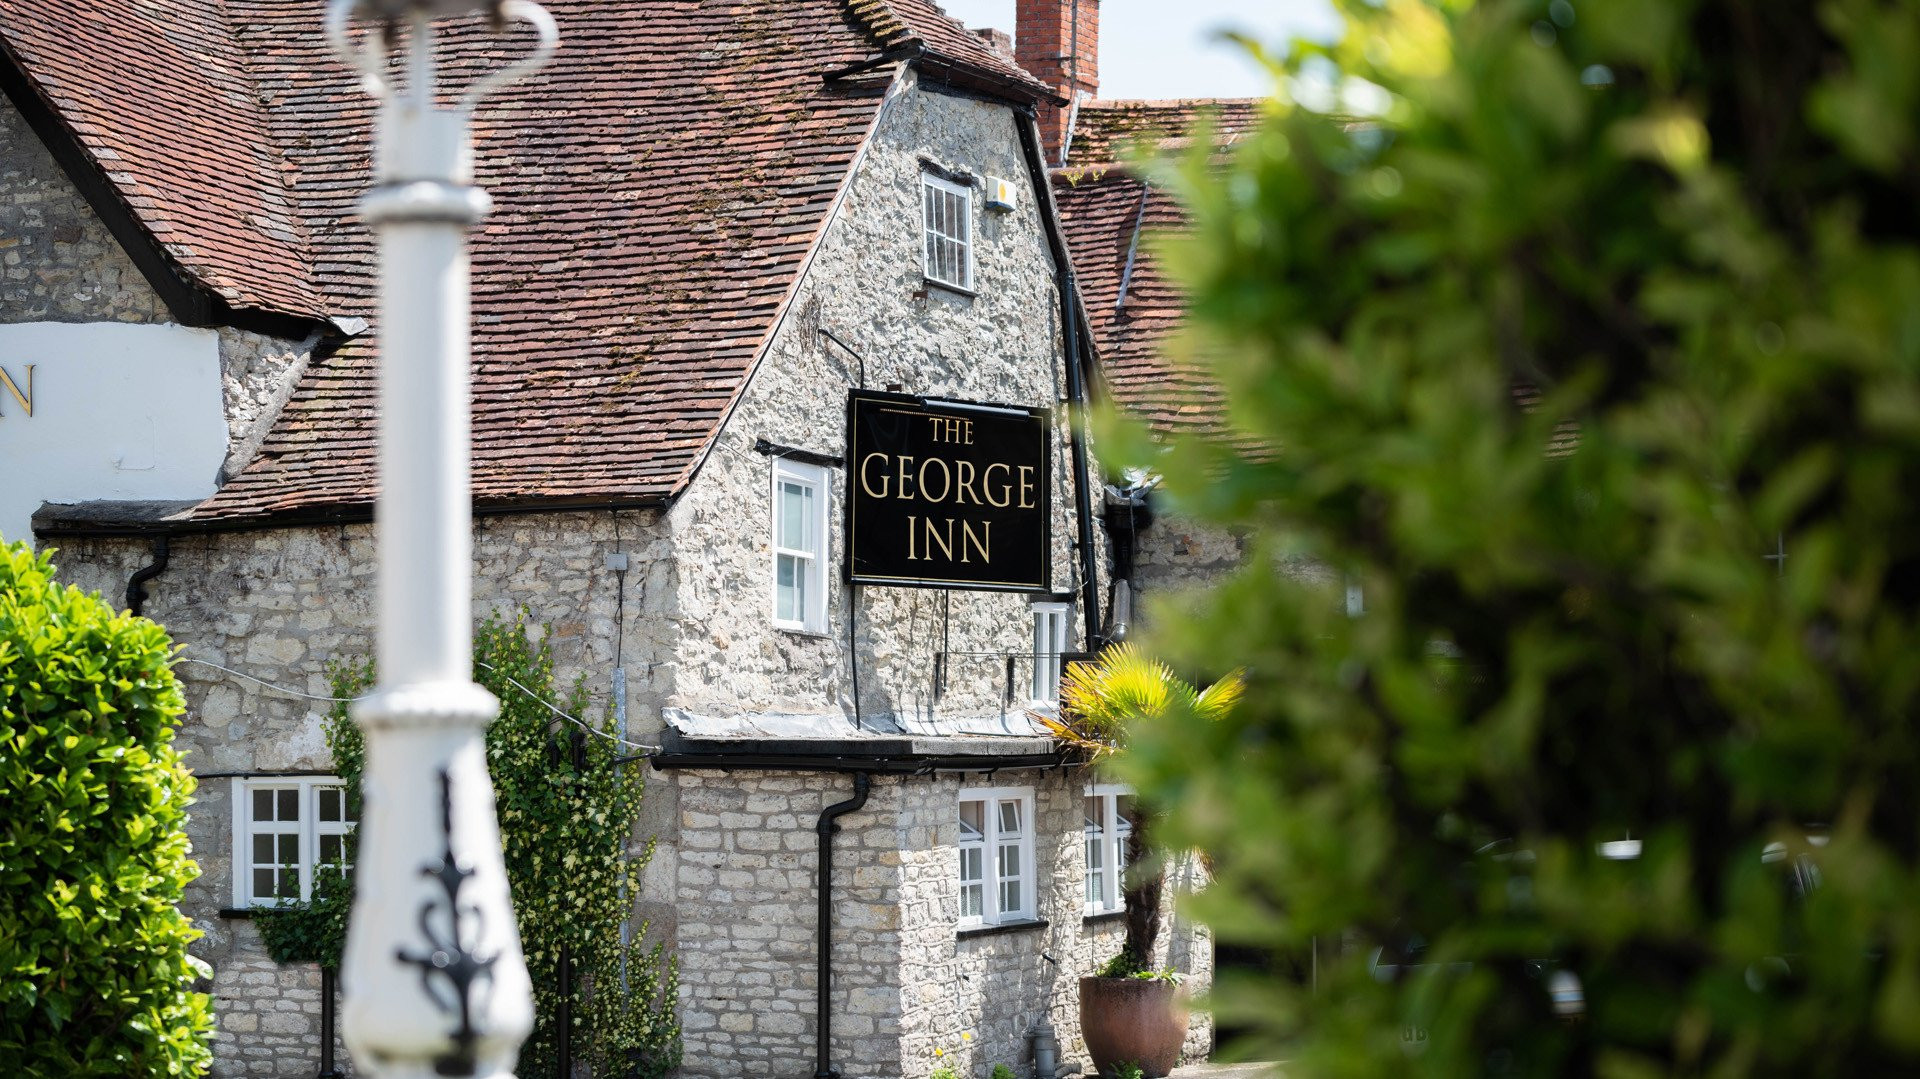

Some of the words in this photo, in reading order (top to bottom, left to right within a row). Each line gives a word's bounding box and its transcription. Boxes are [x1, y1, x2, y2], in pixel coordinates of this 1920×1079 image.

[929, 417, 974, 445] THE
[861, 452, 1036, 509] GEORGE
[907, 515, 991, 564] INN
